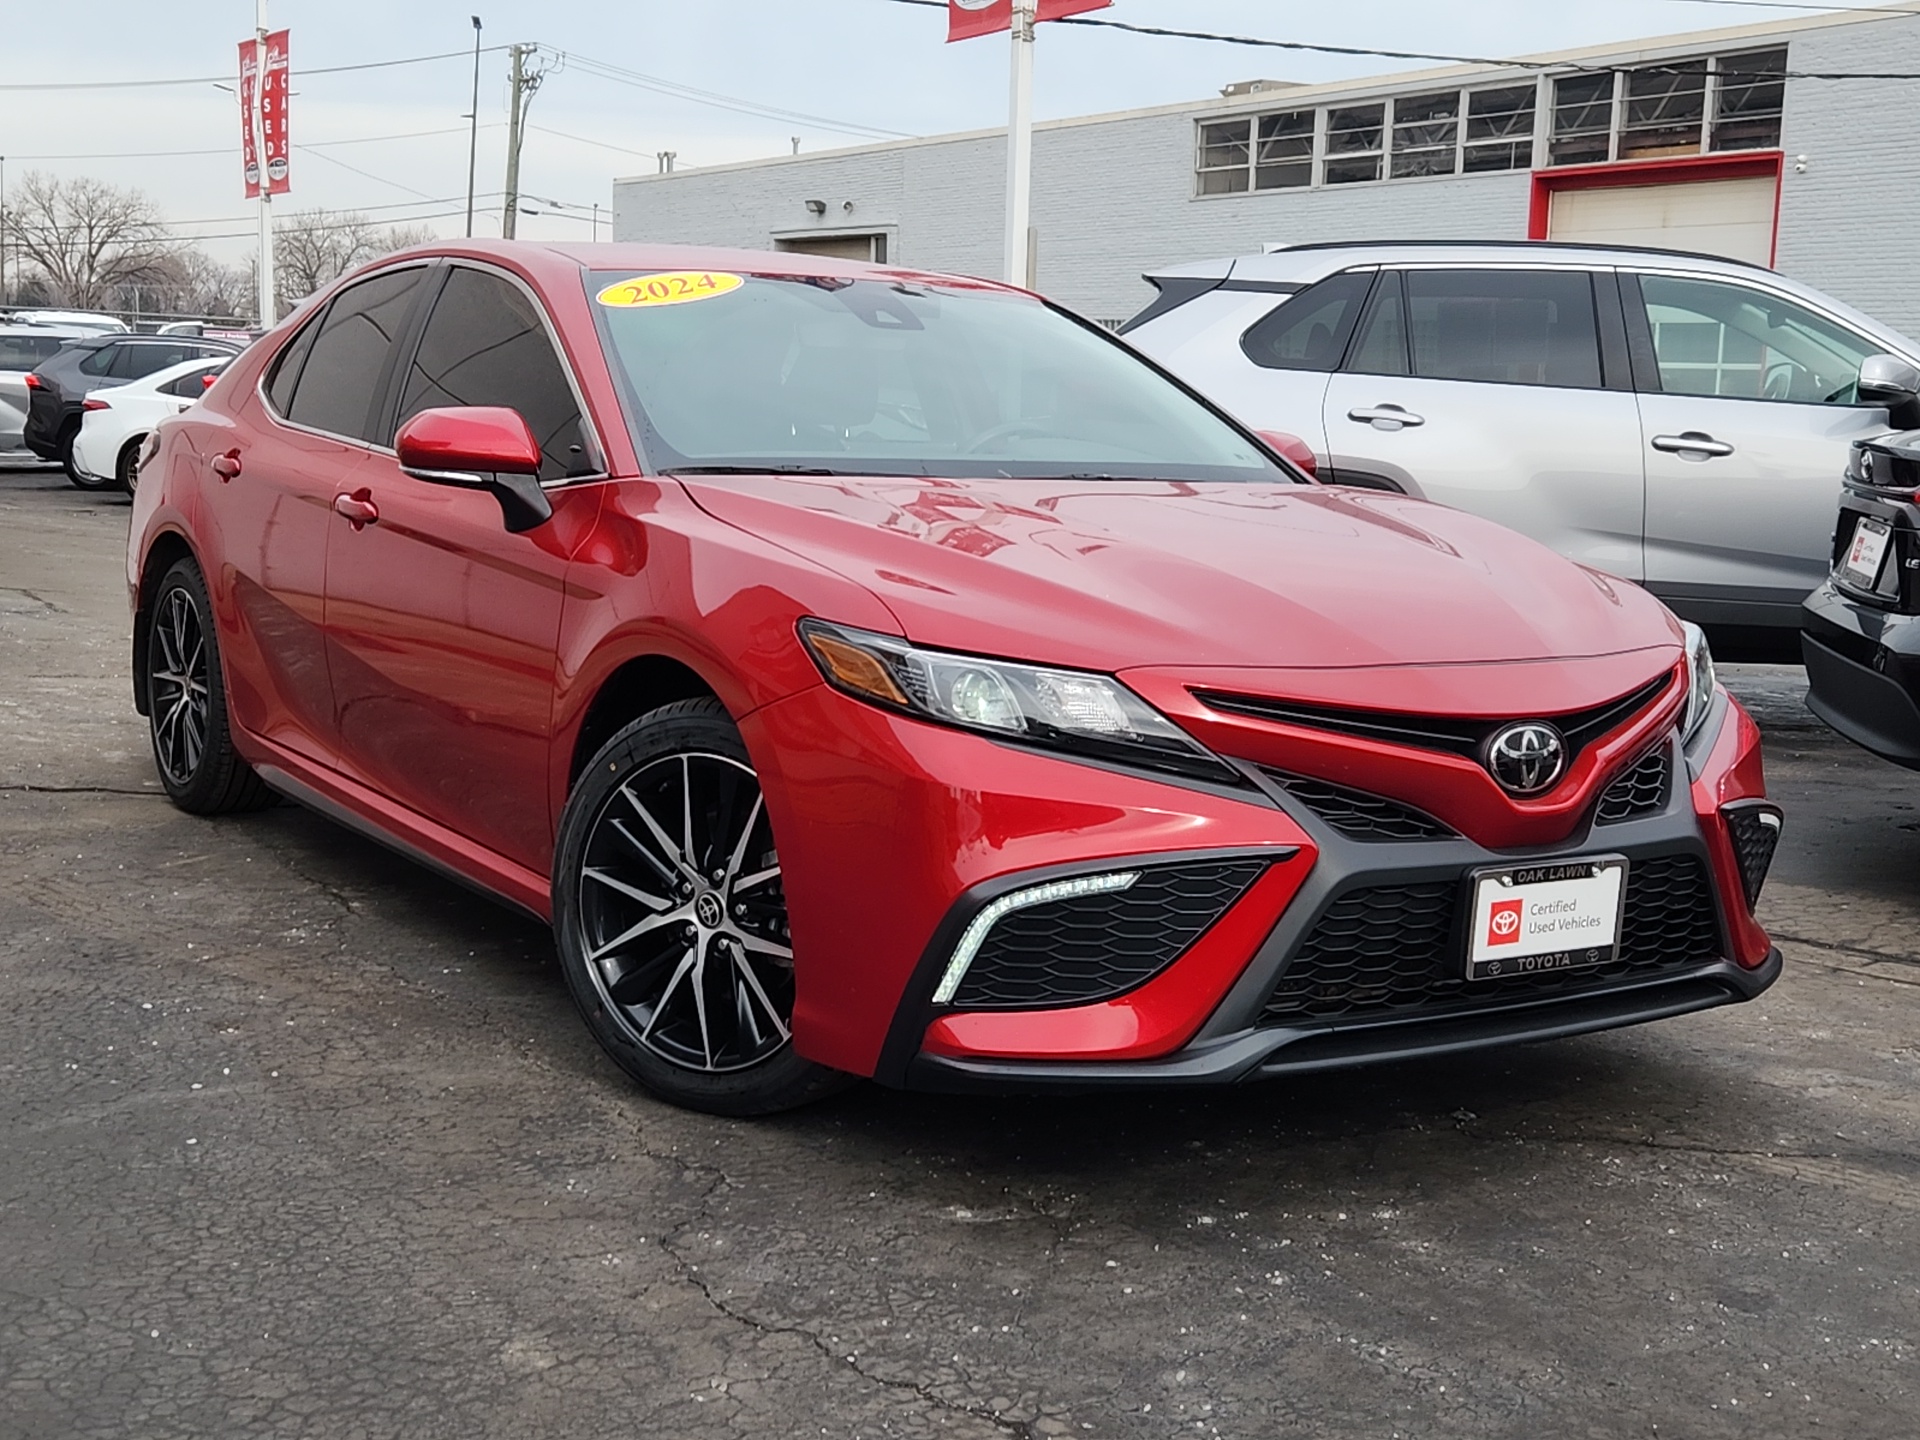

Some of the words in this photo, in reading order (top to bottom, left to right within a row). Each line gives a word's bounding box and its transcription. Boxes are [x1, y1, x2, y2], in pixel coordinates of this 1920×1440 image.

[263, 76, 274, 156] USED
[623, 274, 717, 304] 2024
[1517, 869, 1545, 883] OAK
[1549, 865, 1588, 880] LAWN
[1530, 899, 1577, 916] Certified
[1529, 919, 1556, 934] Used
[1558, 915, 1601, 931] Vehicles
[1517, 953, 1571, 971] TOYOTA
